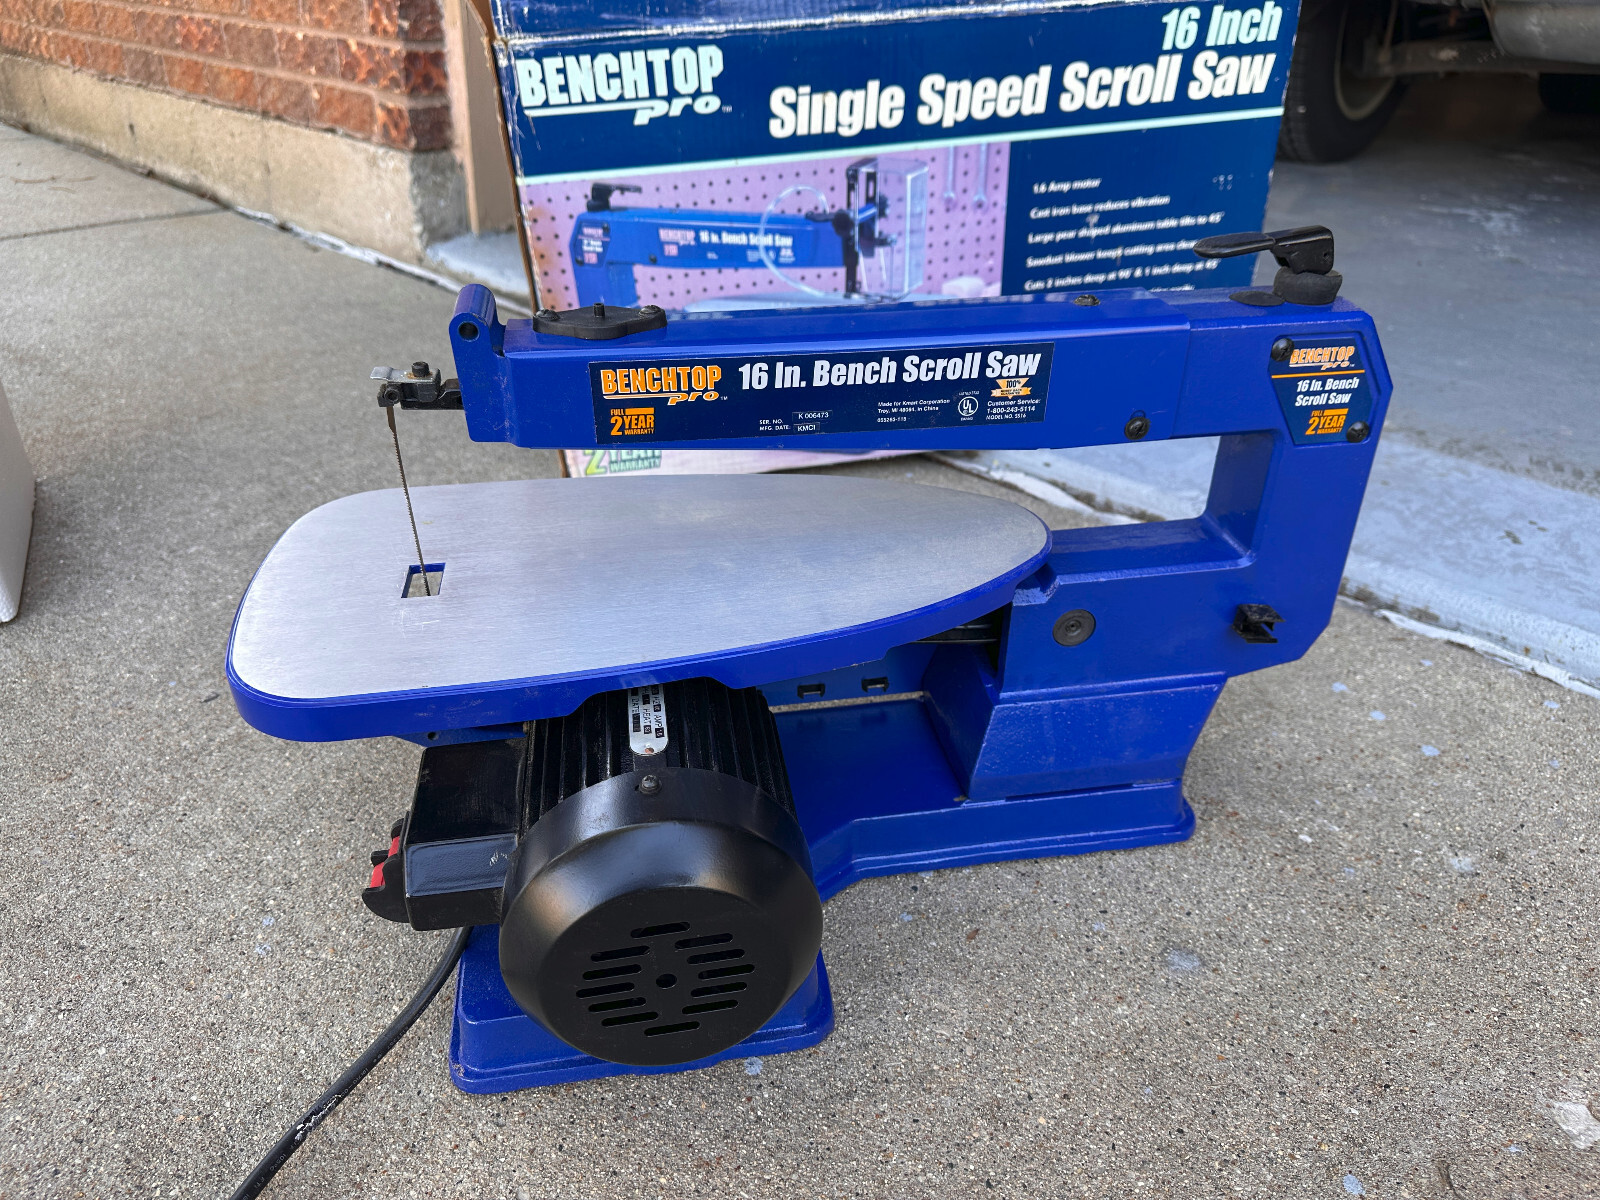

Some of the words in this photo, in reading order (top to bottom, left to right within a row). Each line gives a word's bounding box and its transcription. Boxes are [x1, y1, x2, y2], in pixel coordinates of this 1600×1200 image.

[1161, 6, 1201, 50] 16
[1205, 1, 1283, 47] Inch
[515, 44, 724, 107] BENCHTOP
[768, 78, 906, 139] Single
[916, 64, 1052, 128] Speed
[1059, 53, 1183, 112] Scroll
[1187, 50, 1277, 100] Saw
[632, 94, 721, 126] pro
[1048, 181, 1071, 193] Amp
[1071, 178, 1102, 190] motor
[1029, 207, 1050, 219] Cast
[1071, 203, 1094, 215] base
[1094, 200, 1130, 213] reduces
[1130, 194, 1171, 208] vibration
[1027, 232, 1055, 244] Large
[1024, 280, 1046, 291] Cuts
[1046, 277, 1054, 289] 2
[1054, 275, 1083, 287] inches
[1083, 272, 1107, 284] deep
[1133, 266, 1143, 278] &
[1144, 266, 1151, 277] 1
[1151, 264, 1171, 276] inch
[1171, 262, 1194, 274] deep
[1289, 346, 1355, 364] BENCHTOP
[600, 365, 721, 394] BENCHTOP
[738, 363, 768, 390] 16
[774, 361, 806, 389] In.
[812, 356, 897, 387] Bench
[902, 352, 981, 381] Scroll
[985, 350, 1041, 378] Saw
[1296, 380, 1310, 393] 16
[1310, 379, 1323, 391] In.
[1324, 377, 1360, 391] Bench
[667, 391, 719, 405] pro
[1294, 393, 1328, 407] Scroll
[1328, 392, 1352, 405] Saw
[610, 408, 624, 416] FULL
[798, 412, 804, 420] K
[804, 411, 829, 419] 006473
[610, 415, 623, 436] 2
[623, 414, 655, 429] YEAR
[1305, 416, 1320, 436] 2
[1319, 415, 1347, 429] YEAR
[609, 457, 662, 473] WARRANTY
